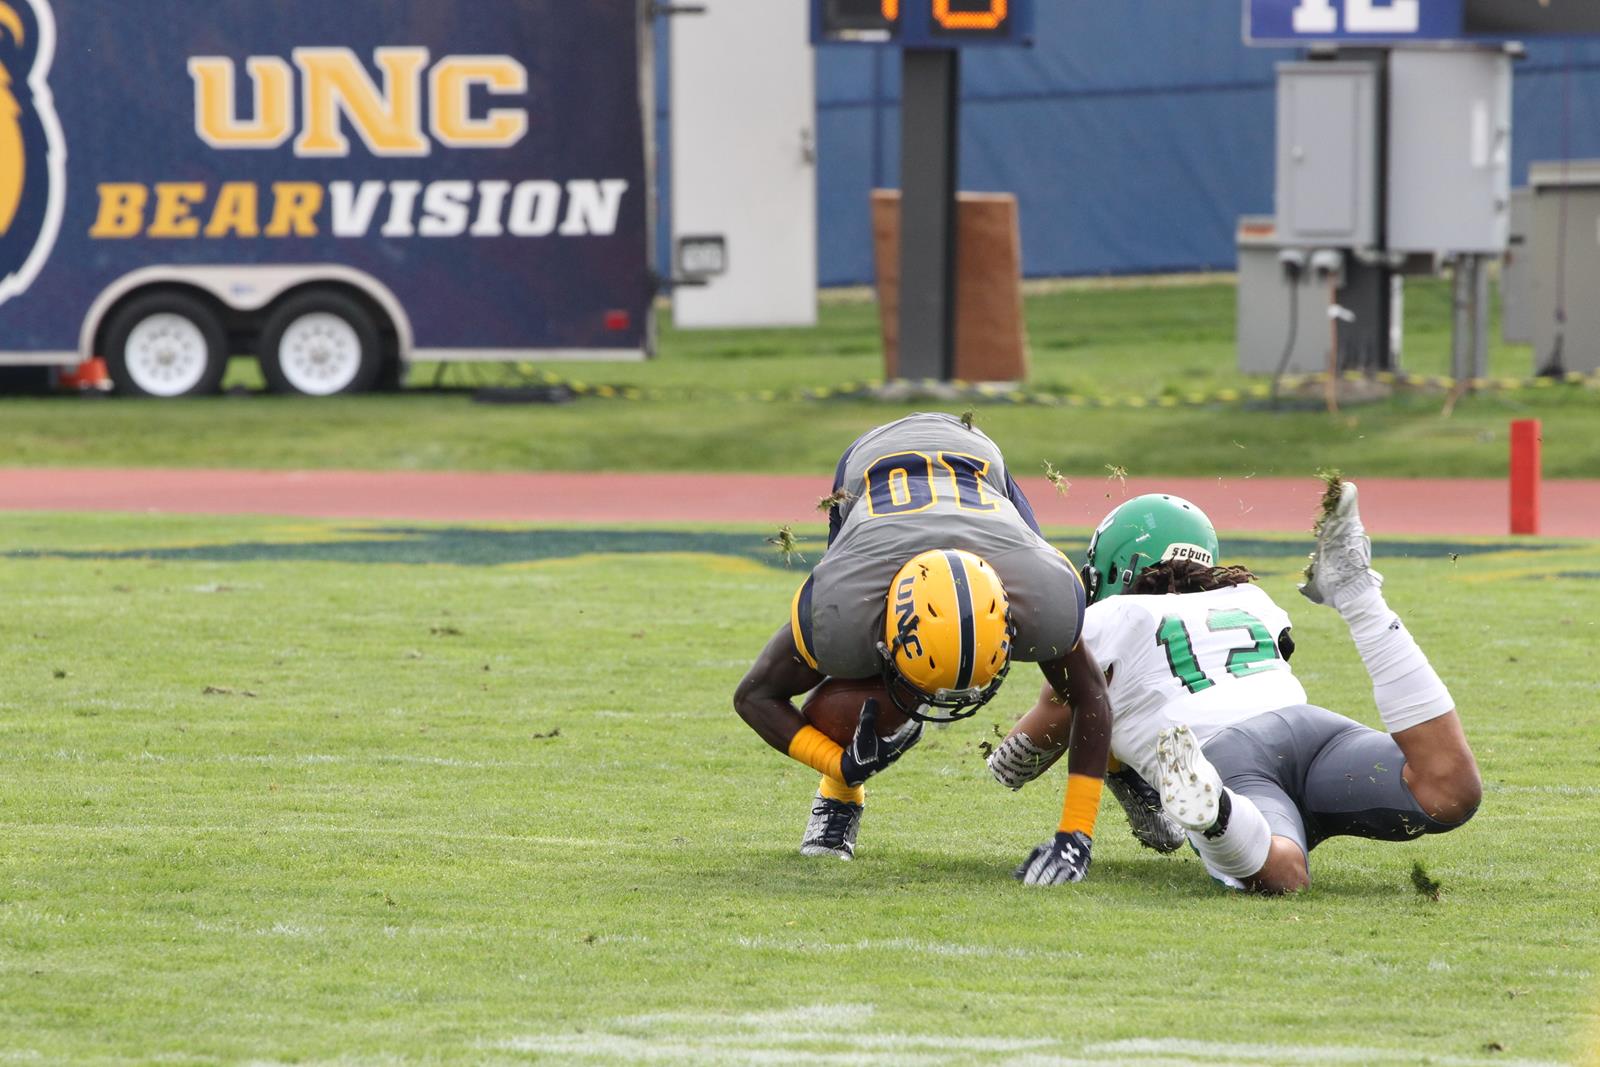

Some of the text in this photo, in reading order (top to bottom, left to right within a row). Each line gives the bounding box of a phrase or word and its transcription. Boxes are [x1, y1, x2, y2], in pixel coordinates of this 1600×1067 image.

[187, 46, 529, 157] UNC
[895, 575, 923, 659] UNC
[1155, 607, 1280, 694] 12
